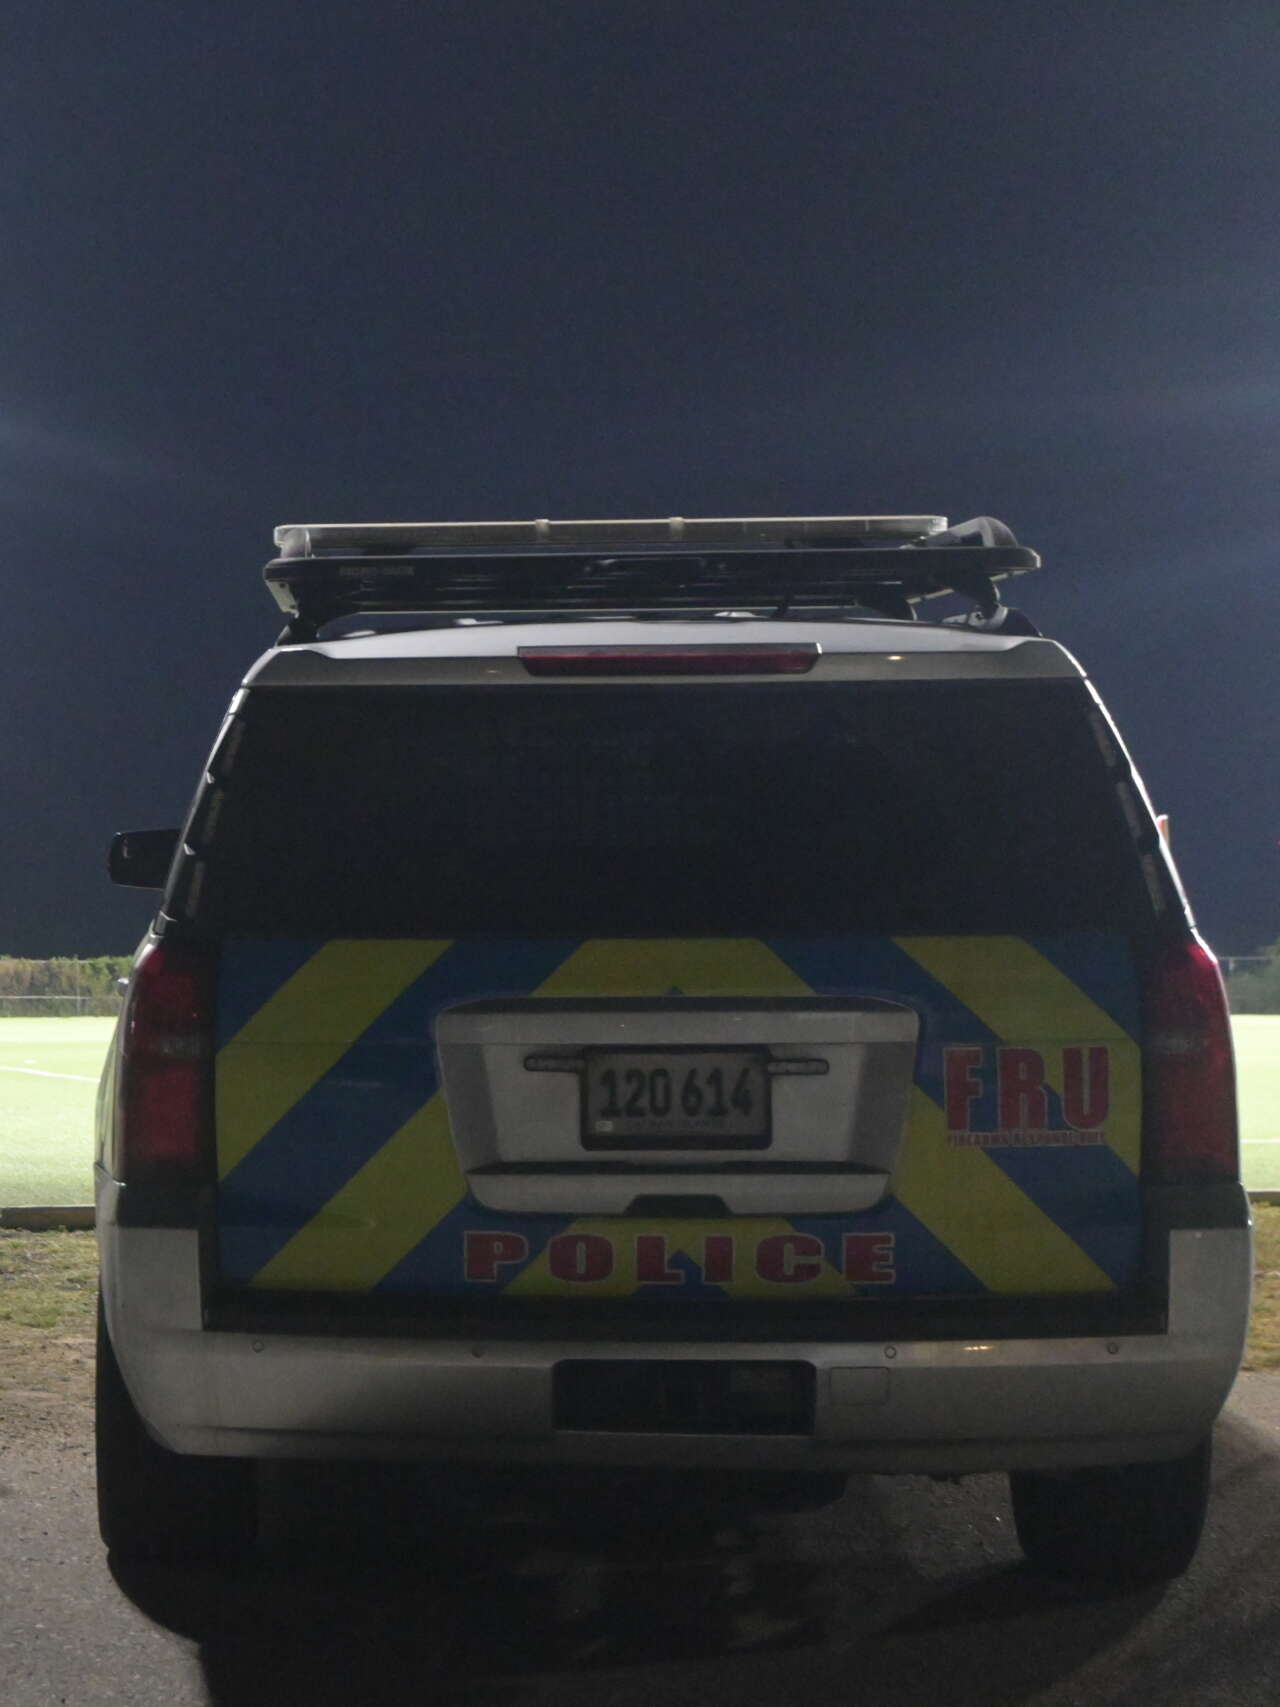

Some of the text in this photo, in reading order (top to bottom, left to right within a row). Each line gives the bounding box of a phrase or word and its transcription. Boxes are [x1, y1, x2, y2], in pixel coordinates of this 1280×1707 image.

[599, 1067, 753, 1117] 120 614
[943, 1044, 1110, 1131] FRU
[463, 1229, 896, 1284] POLICE
